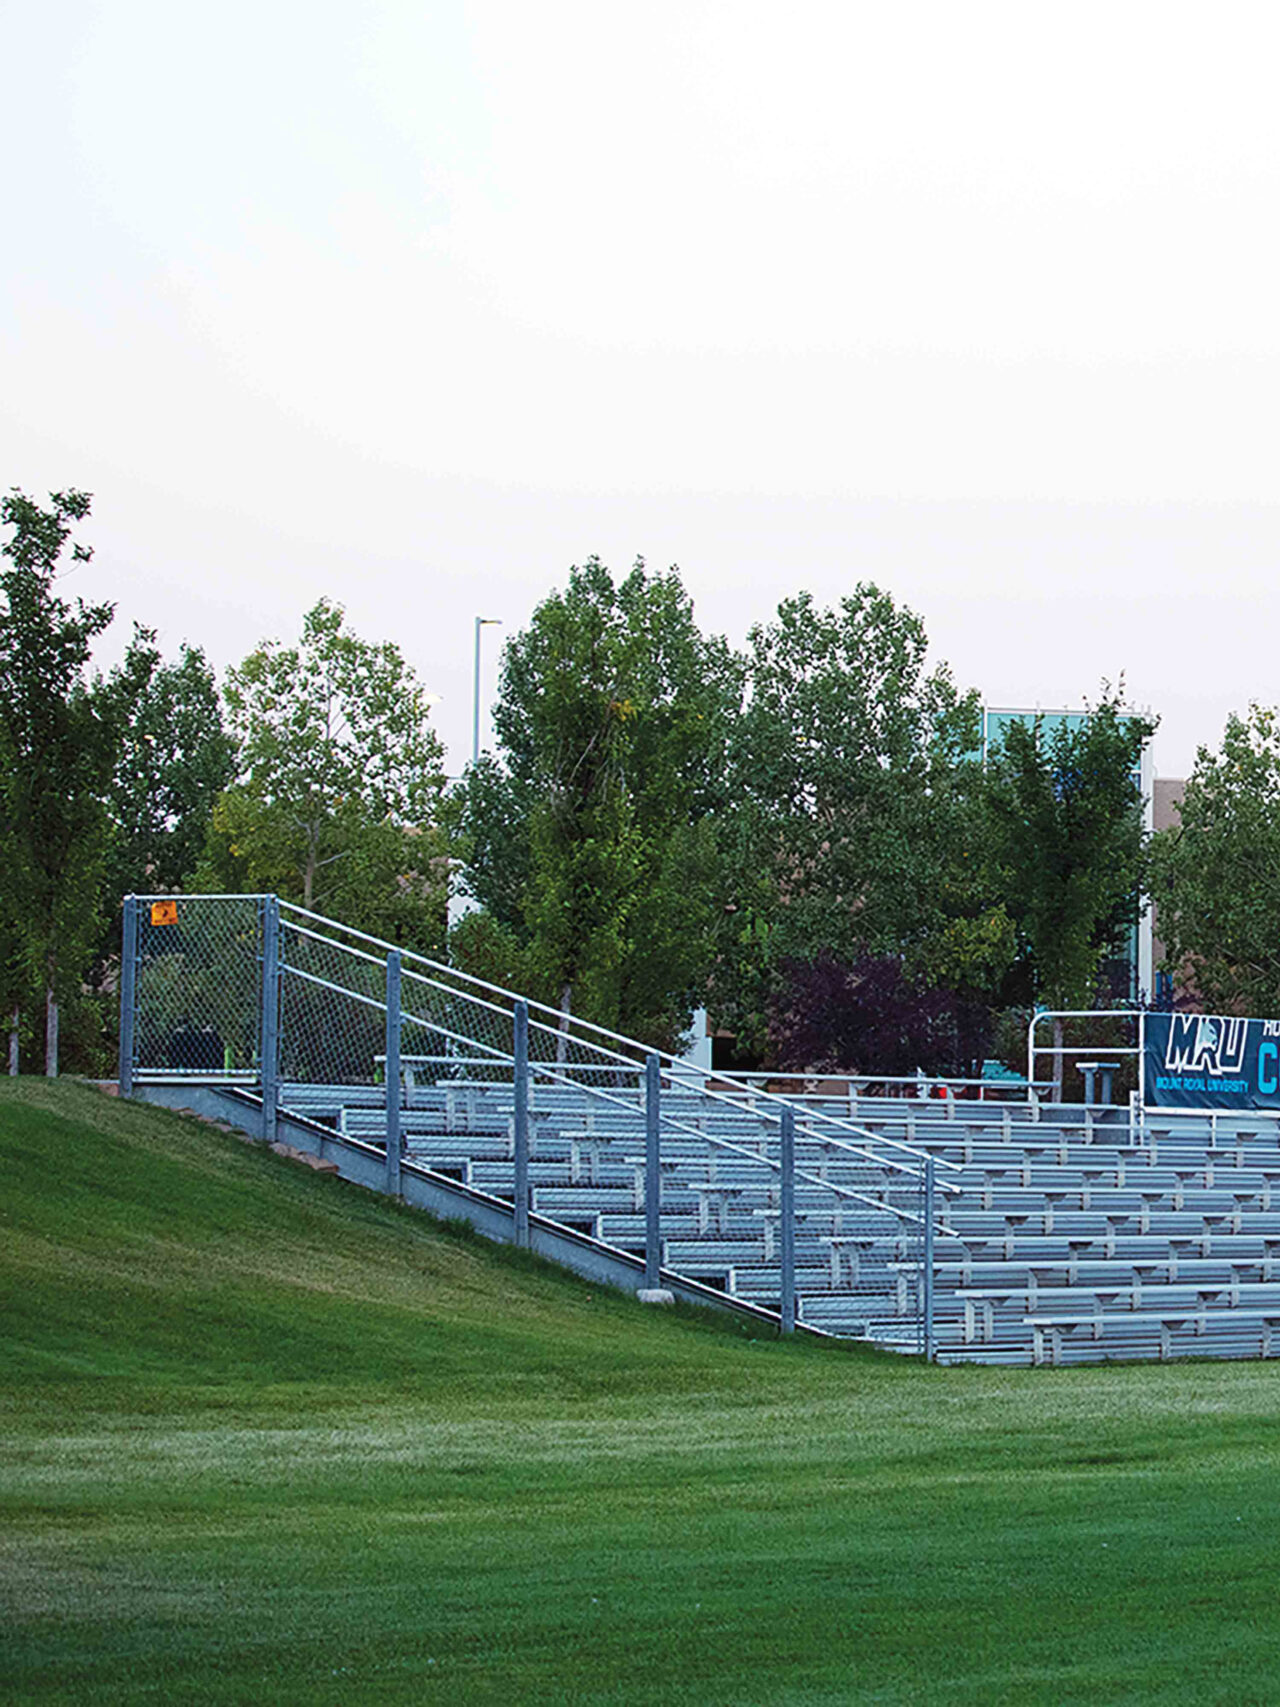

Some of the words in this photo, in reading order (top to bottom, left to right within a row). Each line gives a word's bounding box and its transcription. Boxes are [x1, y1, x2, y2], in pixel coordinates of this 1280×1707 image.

[1165, 1014, 1248, 1075] MRU
[1156, 1076, 1182, 1091] MOUNT
[1207, 1078, 1250, 1093] UNIVERSITY
